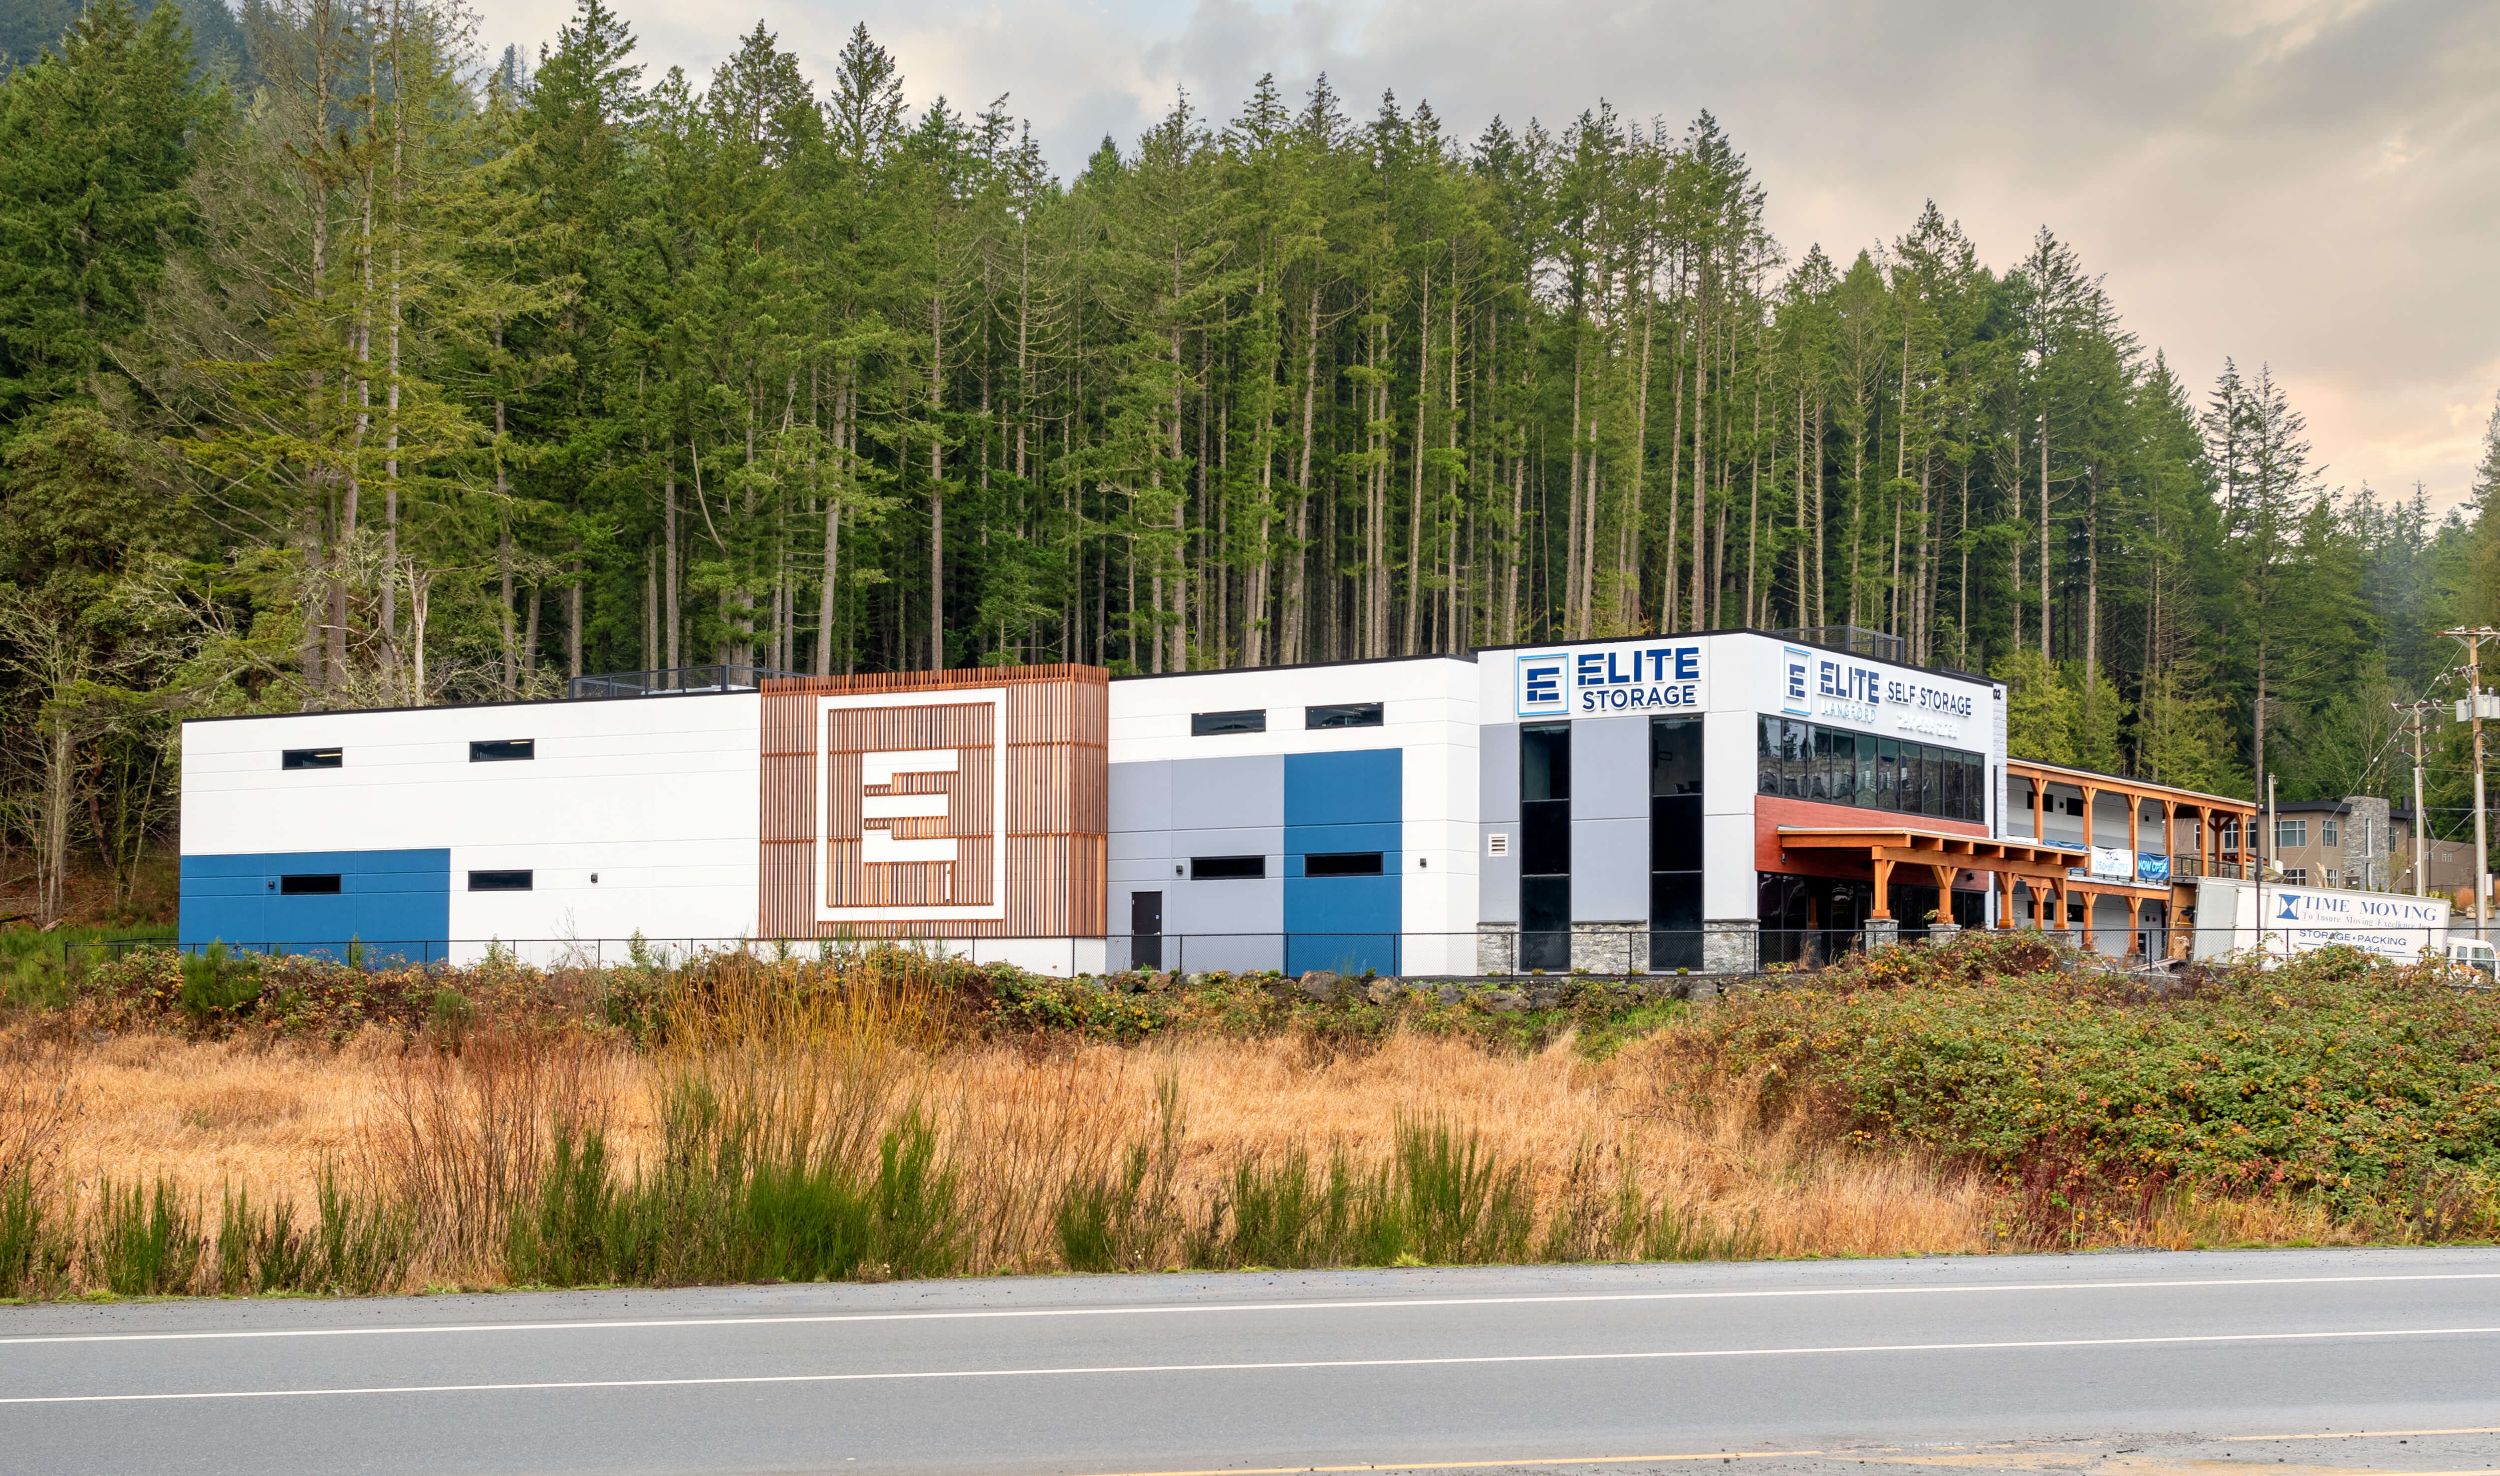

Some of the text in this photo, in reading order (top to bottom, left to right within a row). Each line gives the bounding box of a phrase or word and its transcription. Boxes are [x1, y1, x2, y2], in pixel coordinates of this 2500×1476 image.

[1577, 646, 1700, 686] ELITE
[1582, 684, 1696, 710] STORAGE
[1820, 660, 1972, 716] ELITE SELF STORAGE
[2303, 895, 2437, 921] TIME MOVING
[2346, 915, 2374, 927] Moving
[2357, 934, 2407, 946] PACKING
